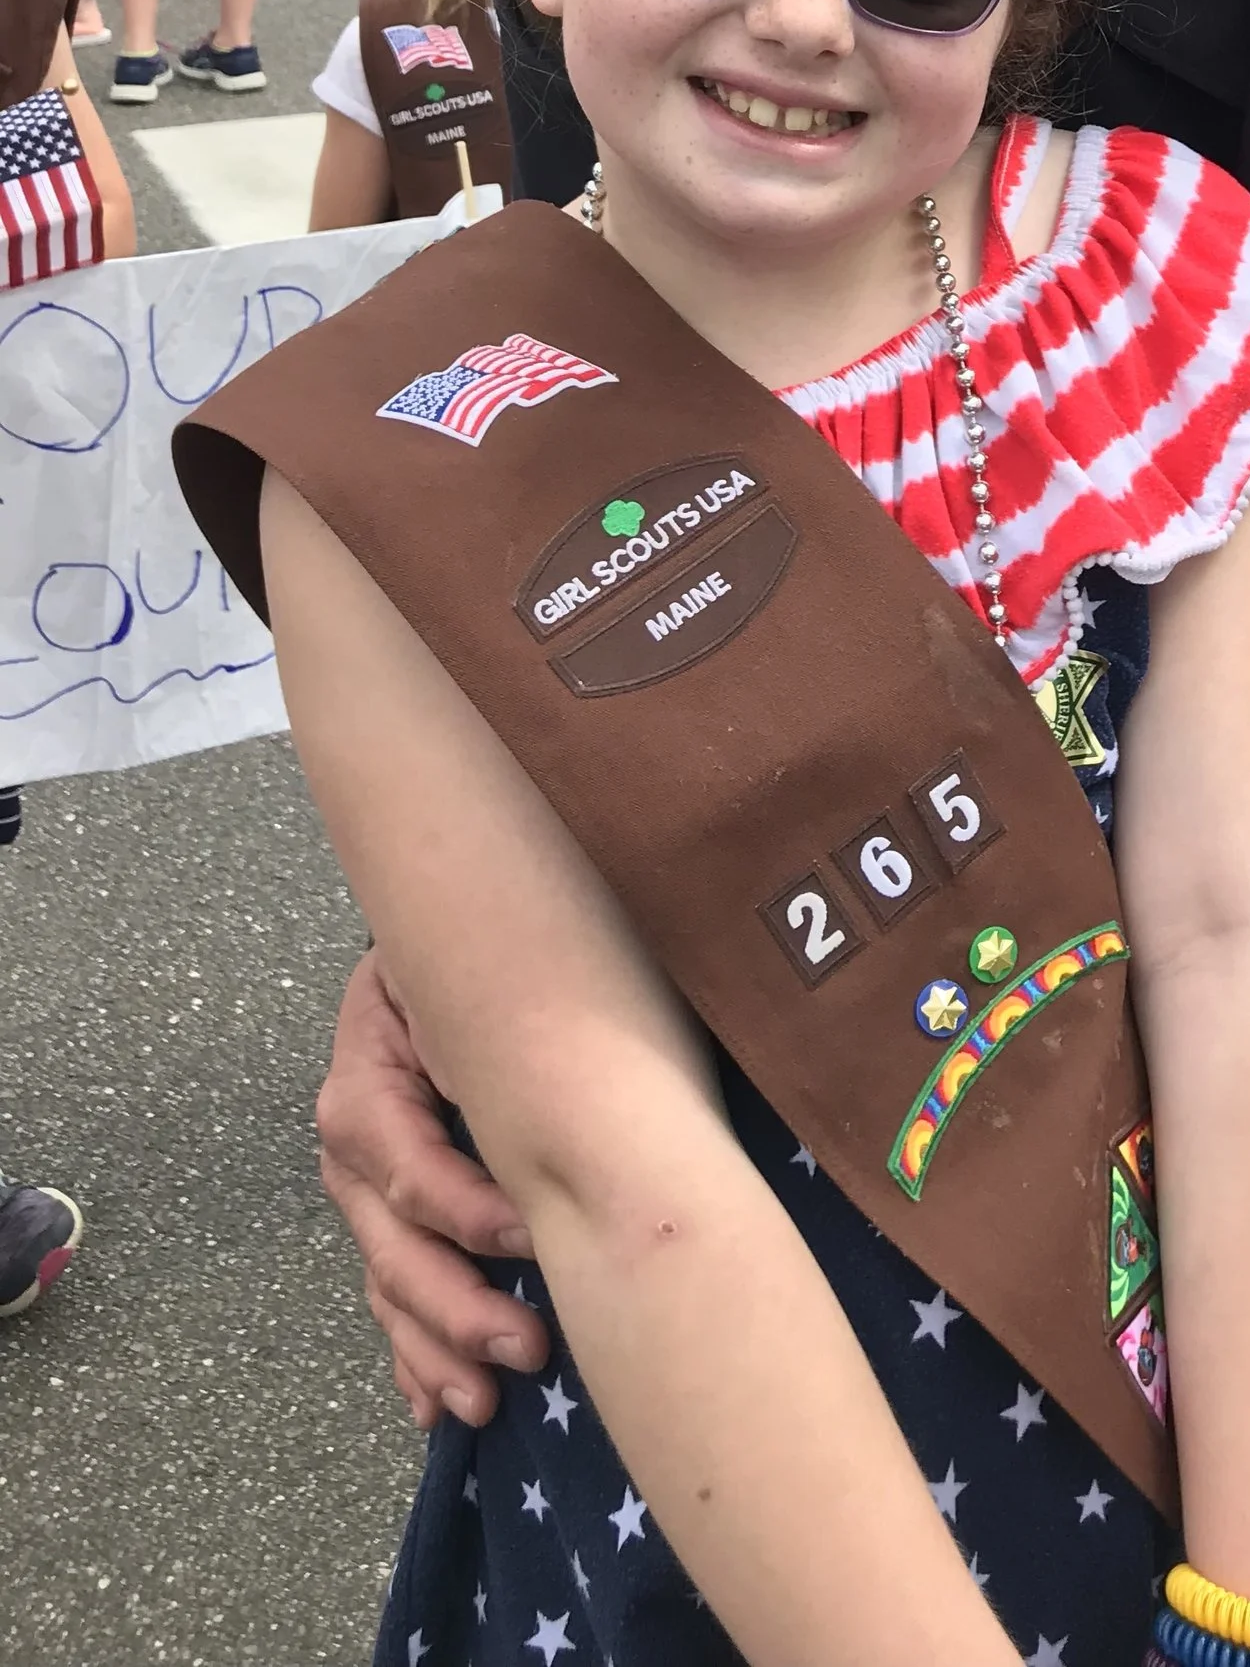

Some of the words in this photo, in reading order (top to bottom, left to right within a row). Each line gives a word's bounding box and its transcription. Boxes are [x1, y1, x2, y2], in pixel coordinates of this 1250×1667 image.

[416, 96, 466, 119] SCOUTS
[466, 90, 493, 106] USA
[427, 125, 467, 144] MAINE
[533, 577, 601, 624] GIRL
[591, 502, 702, 586] SCOUTS
[694, 469, 756, 513] USA
[644, 571, 732, 642] MAINE
